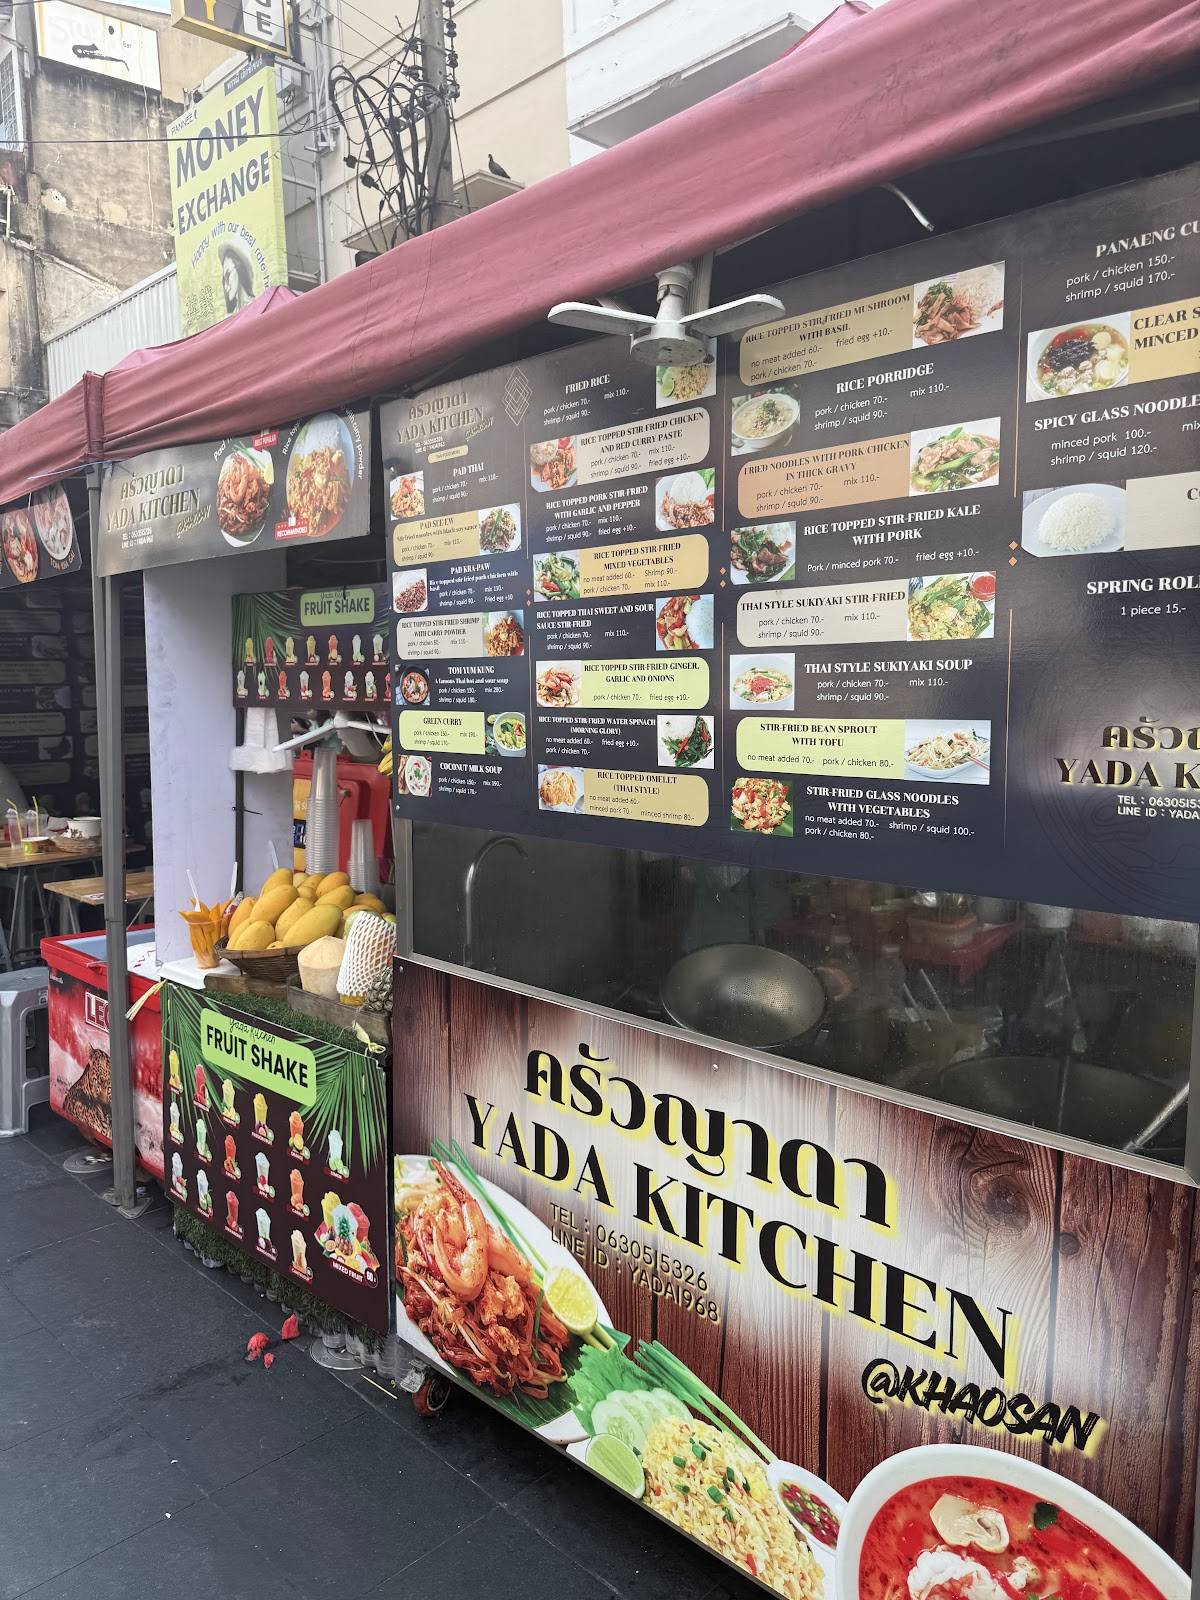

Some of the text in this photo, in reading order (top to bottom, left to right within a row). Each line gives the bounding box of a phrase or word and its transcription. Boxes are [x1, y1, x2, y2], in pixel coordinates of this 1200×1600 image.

[176, 88, 264, 188] MONEY
[177, 151, 270, 236] EXCHANGE
[1096, 227, 1176, 258] PANAENG
[1066, 272, 1090, 289] pork
[1102, 260, 1144, 278] chicken
[746, 332, 765, 343] RICE
[768, 323, 800, 338] TOPPED
[854, 294, 910, 314] MUSHROOM
[1134, 310, 1187, 330] CLEAR
[799, 324, 850, 342] WITH BASIL
[836, 336, 854, 347] fried
[857, 333, 870, 343] egg
[1135, 328, 1198, 350] MINCED
[565, 374, 610, 394] FRIED RICE
[836, 363, 934, 394] RICE PORRIDGE
[604, 391, 614, 400] mix
[910, 388, 926, 398] mix
[397, 425, 426, 444] YADA
[429, 407, 484, 436] KITCHEN
[1034, 413, 1078, 431] SPICY
[1081, 405, 1129, 424] GLASS
[1052, 436, 1089, 450] minced
[1093, 433, 1117, 446] pork
[453, 462, 484, 477] PAD THAI
[107, 506, 136, 532] YADA
[140, 488, 200, 523] KITCHEN
[546, 501, 560, 510] RICE
[562, 496, 588, 507] TOPPED
[589, 492, 608, 502] PORK
[554, 499, 640, 519] WITH GARLIC AND PEPPER
[804, 504, 981, 536] RICE TOPPED STIR-FRIED KALE
[853, 528, 922, 546] WITH PORK
[916, 550, 936, 561] fried
[939, 551, 954, 560] egg
[1087, 578, 1153, 595] SPRING
[304, 597, 370, 616] FRUIT SHAKE
[741, 601, 763, 611] THAI
[764, 599, 794, 610] STYLE
[796, 596, 843, 608] SUKIYAKI
[1121, 606, 1126, 615] 1
[1131, 604, 1161, 617] piece
[844, 614, 859, 622] mix
[463, 666, 477, 674] YUM
[478, 666, 494, 674] KUNG
[804, 659, 972, 674] THAI STYLE SUKIYAKI SOUP
[443, 718, 462, 726] CURRY
[811, 724, 836, 734] BEAN
[838, 724, 877, 734] SPROUT
[792, 737, 844, 747] WITH TOFU
[440, 762, 468, 772] COCONUT
[486, 766, 502, 774] SOUP
[1055, 758, 1162, 787] YADA
[616, 773, 644, 782] TOPPED
[646, 775, 677, 784] OMELET
[807, 786, 959, 806] STIR-FRIED GLASS NOODLES
[1117, 795, 1137, 805] TEL
[828, 802, 930, 819] WITH VEGETABLES
[1118, 806, 1141, 816] LINE
[1146, 808, 1157, 817] ID
[85, 992, 110, 1033] LE
[207, 1024, 308, 1088] FRUIT SHAKE
[524, 1043, 892, 1229] ครัวญาดา
[463, 1092, 1013, 1380] YADA KITCHEN
[550, 1202, 580, 1232] TEL
[596, 1224, 708, 1293] 0630515326
[552, 1226, 586, 1259] LINE
[593, 1245, 610, 1269] ID
[333, 1261, 363, 1282] MIXED FRUIT
[861, 1357, 1101, 1451] @KHAOSAN
